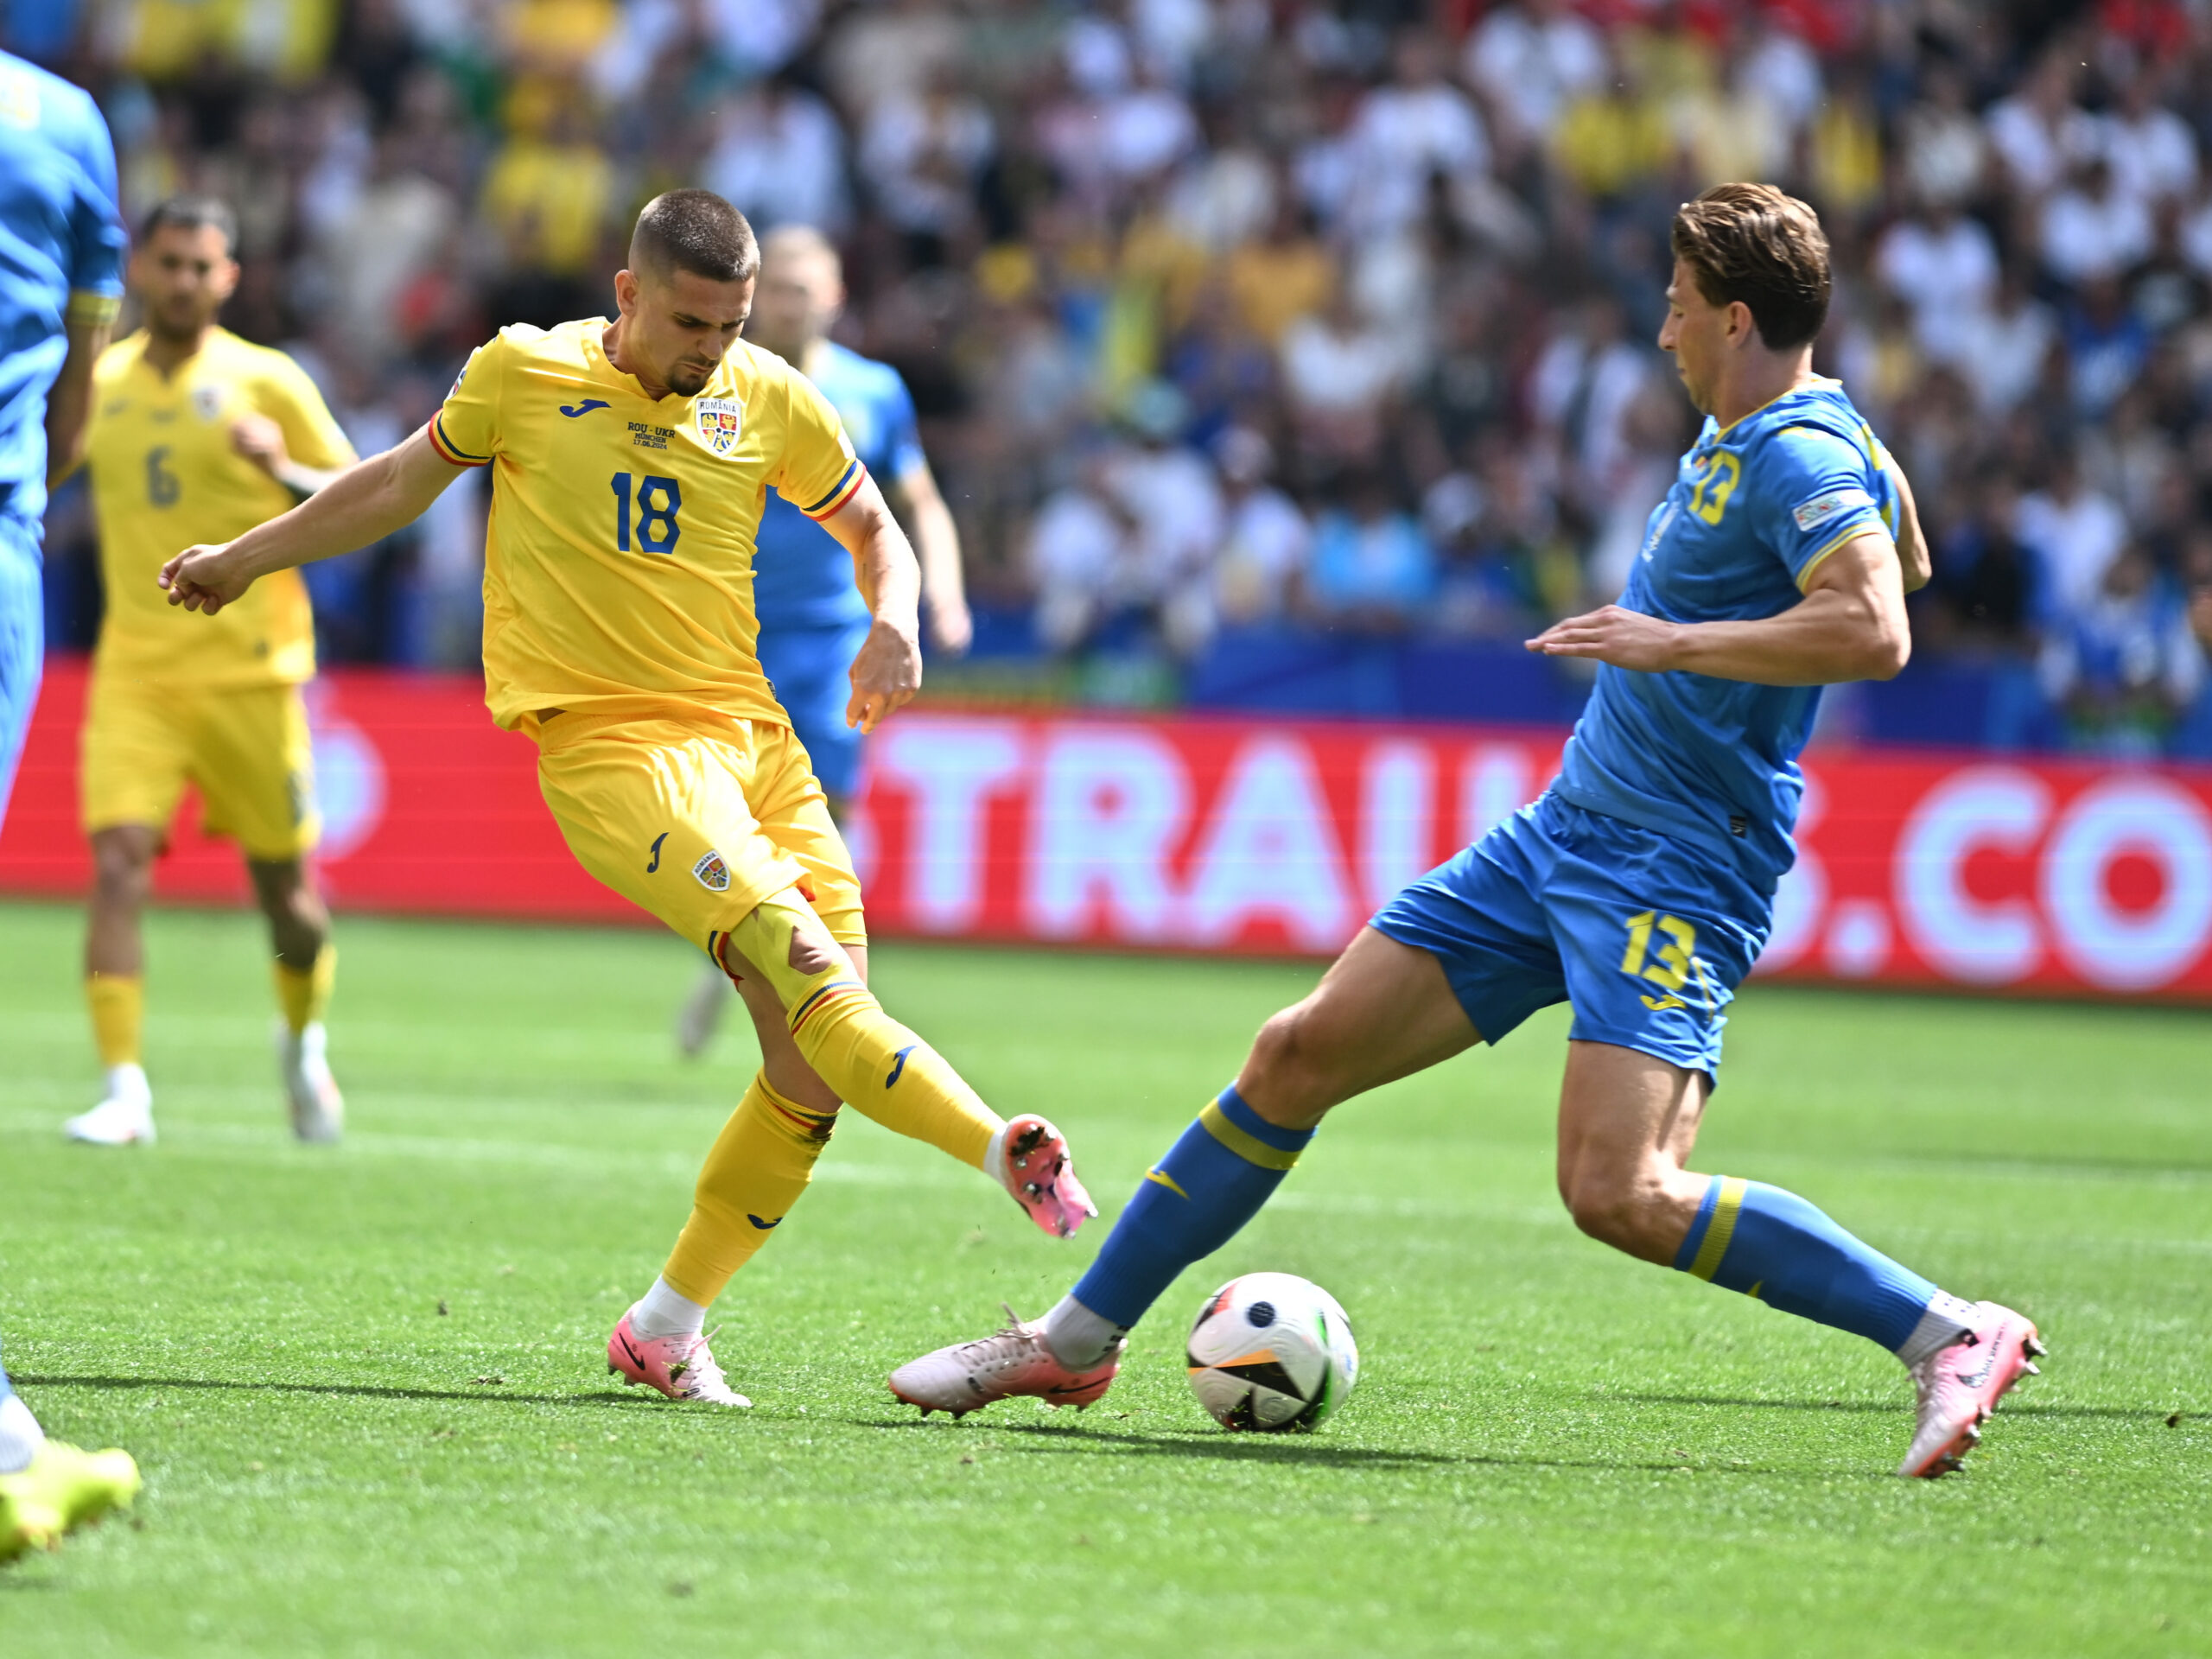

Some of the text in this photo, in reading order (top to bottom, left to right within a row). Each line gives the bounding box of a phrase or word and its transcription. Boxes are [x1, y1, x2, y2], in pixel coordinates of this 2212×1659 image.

[627, 422, 648, 433] ROU
[655, 427, 676, 438] UKR
[699, 399, 737, 413] ROMÂNIA
[633, 439, 667, 449] 17.06.2024
[635, 433, 666, 443] MÜNCHEN
[146, 445, 181, 508] 6
[1688, 450, 1740, 525] 13
[611, 472, 682, 554] 18
[842, 715, 2212, 991] TRAU.CO
[1621, 909, 1695, 991] 13
